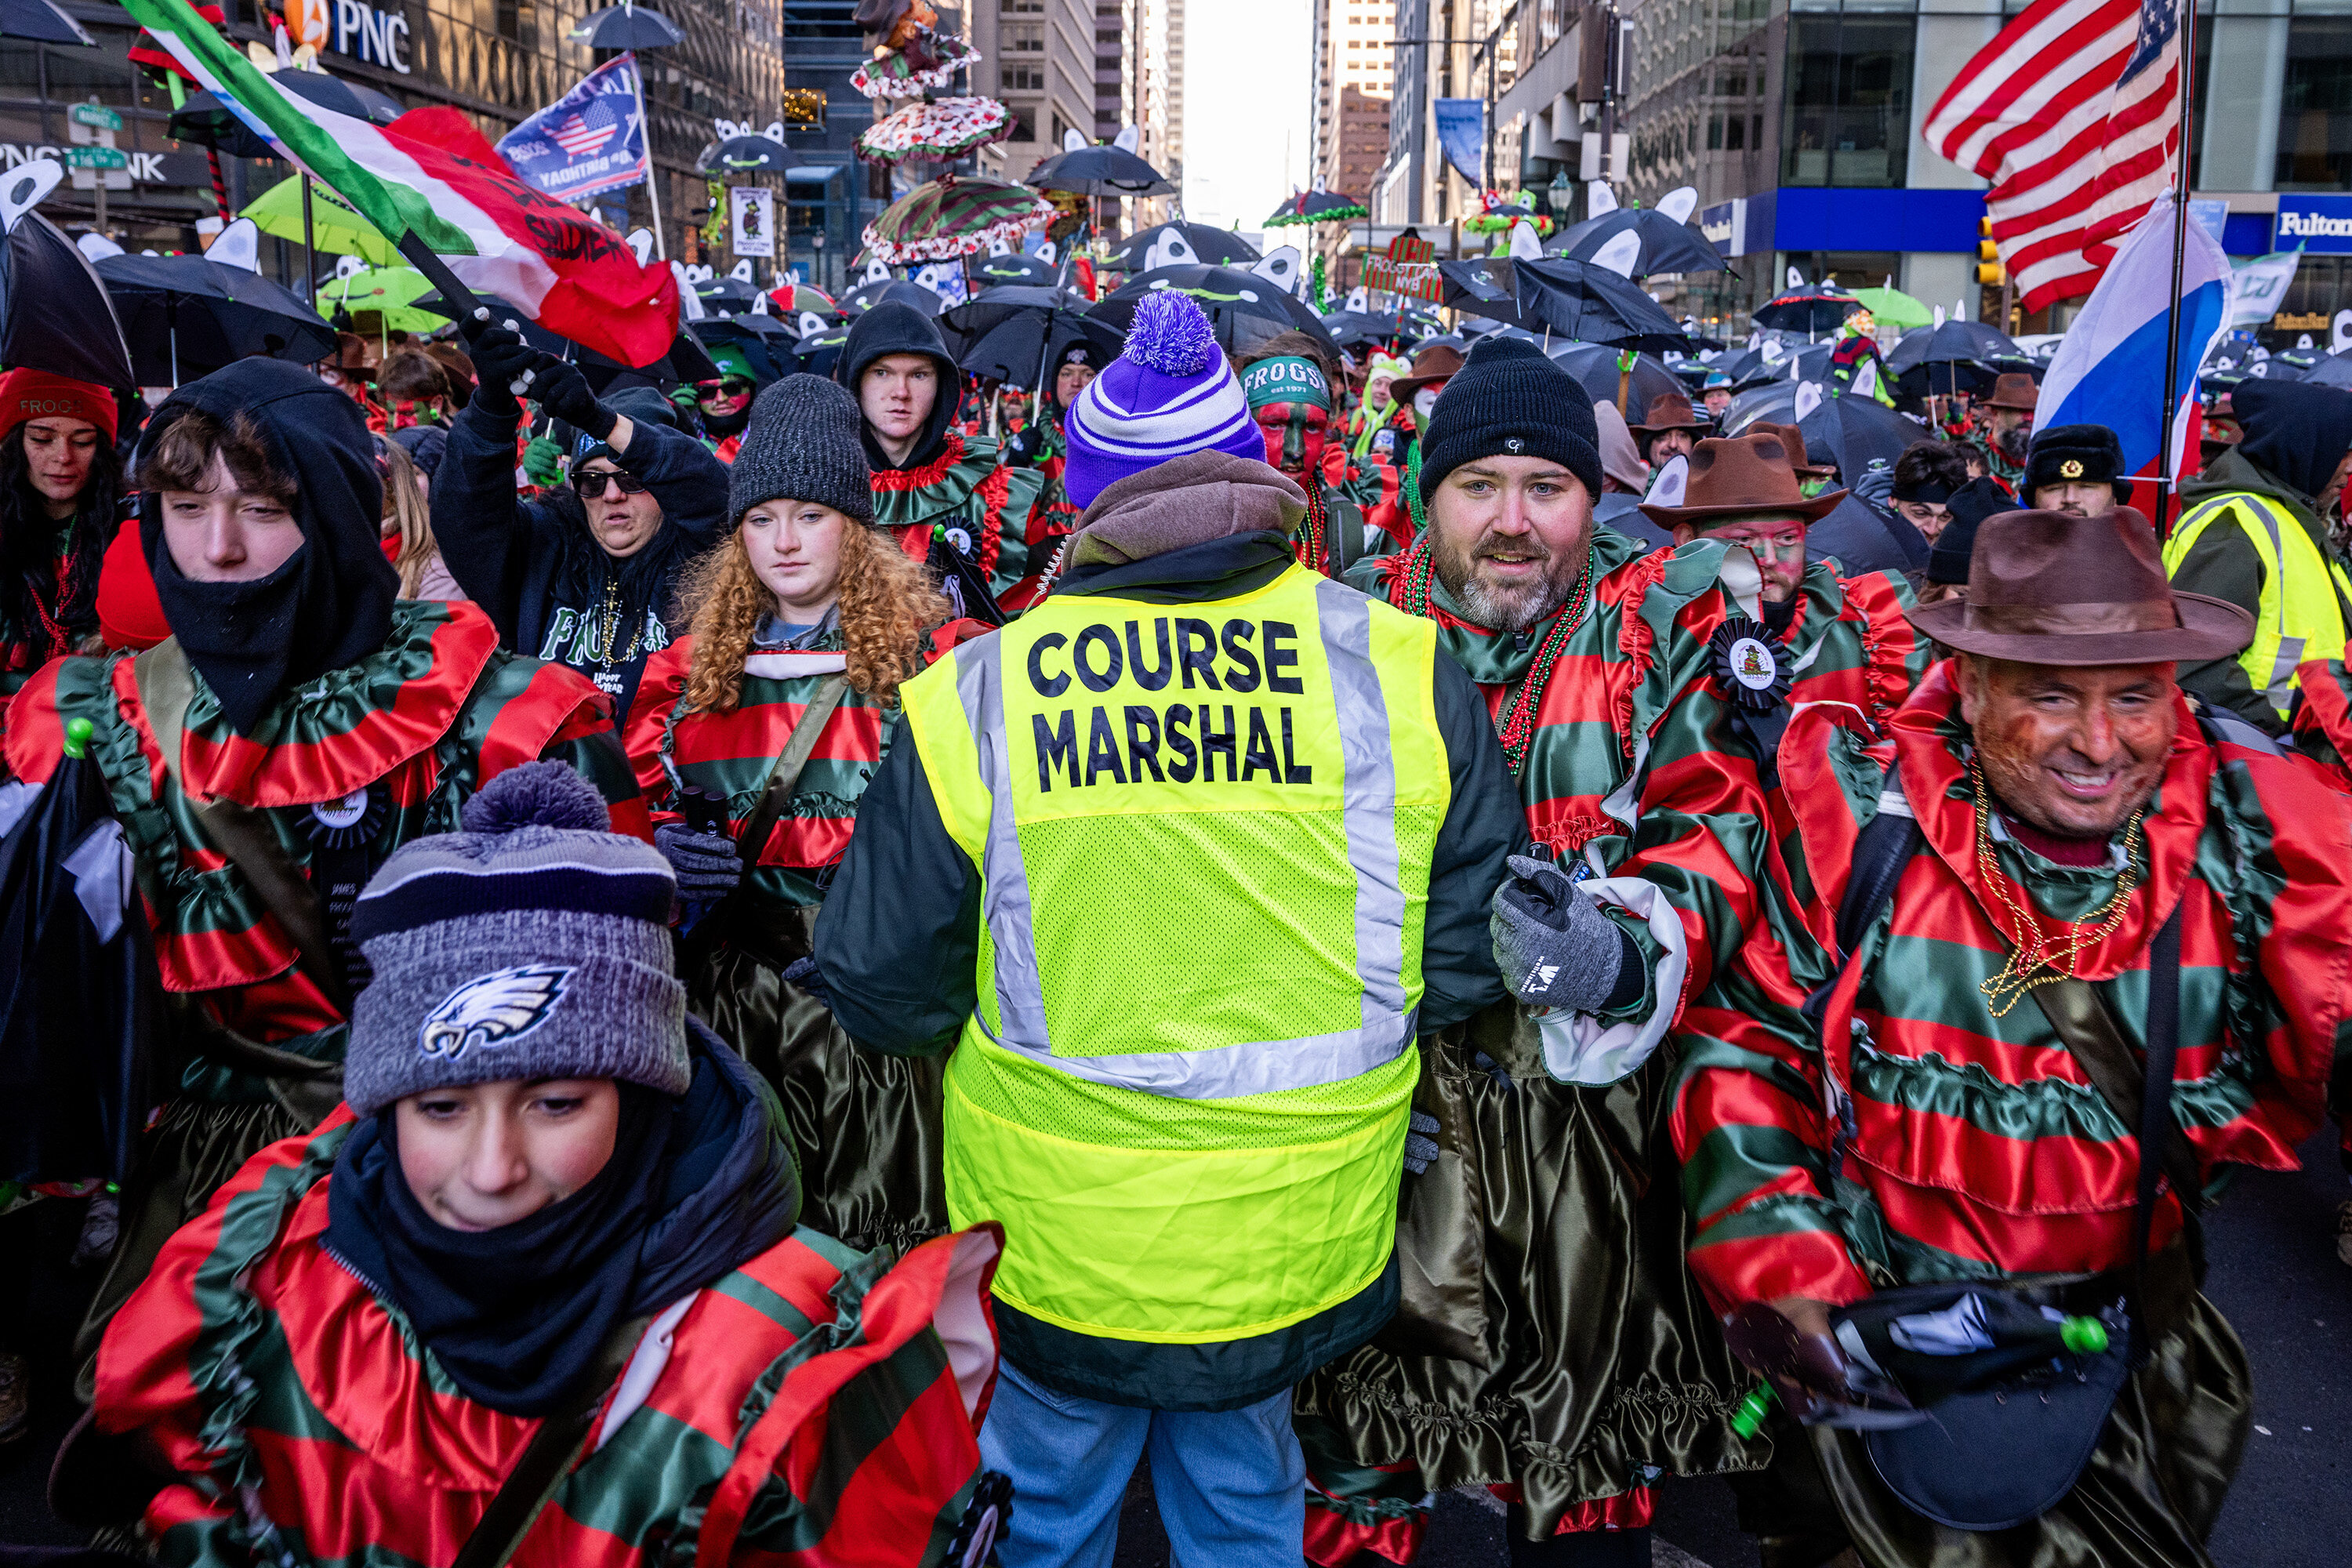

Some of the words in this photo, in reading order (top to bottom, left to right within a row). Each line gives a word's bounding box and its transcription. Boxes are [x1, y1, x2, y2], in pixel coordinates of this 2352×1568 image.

[336, 0, 411, 74] PNC
[2278, 212, 2352, 236] Fulton
[1243, 362, 1321, 397] FROGS
[593, 672, 621, 684] HAPPY
[1027, 617, 1305, 698] COURSE
[1032, 703, 1312, 793] MARSHAL
